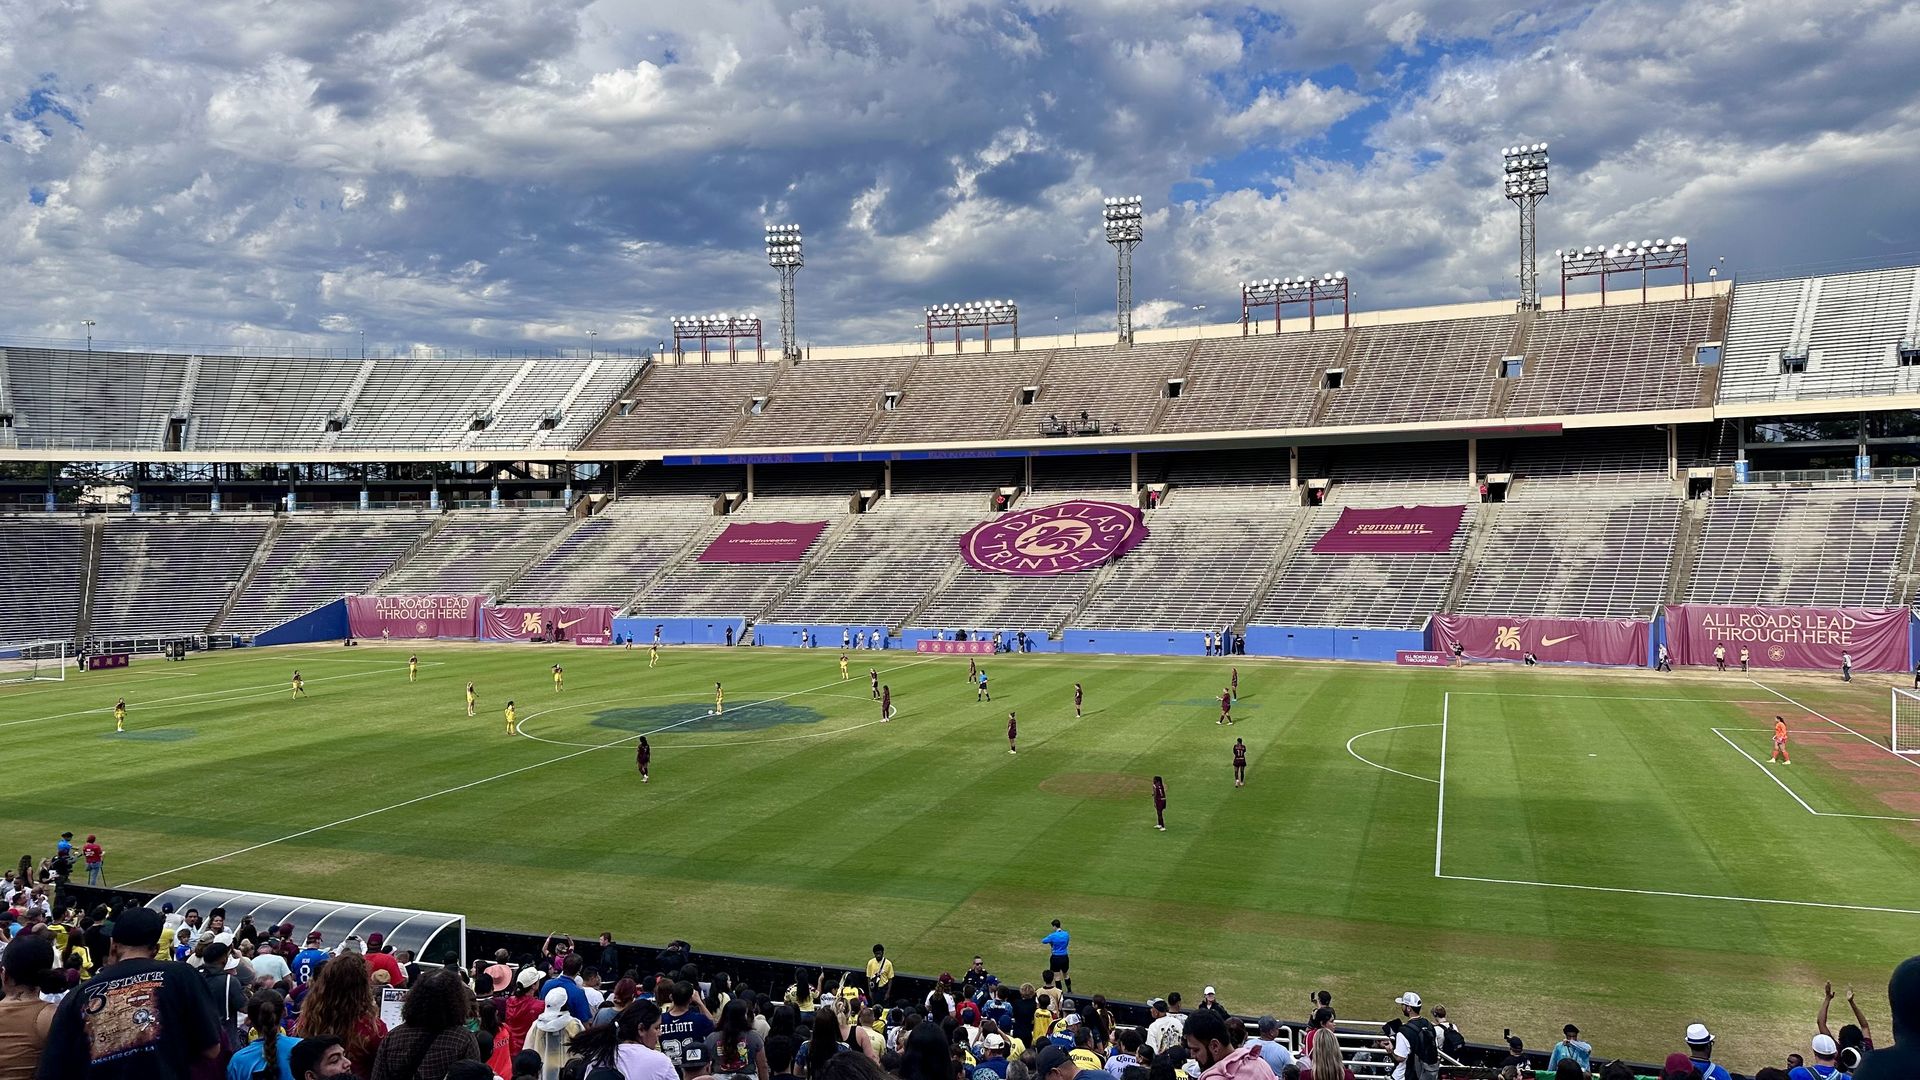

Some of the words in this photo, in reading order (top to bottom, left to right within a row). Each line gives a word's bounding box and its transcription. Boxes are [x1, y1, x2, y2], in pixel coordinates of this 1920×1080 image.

[1002, 507, 1125, 533] DALLAS
[981, 541, 1109, 569] TRINITY
[375, 598, 397, 609] ALL
[399, 598, 437, 609] ROADS
[440, 598, 470, 608] LEAD
[376, 609, 435, 620] THROUGH
[437, 609, 467, 619] HERE
[1702, 613, 1735, 627] ALL
[1739, 614, 1802, 629] ROADS
[1806, 616, 1856, 630] LEAD
[1705, 627, 1798, 643] THROUGH
[1802, 630, 1853, 645] HERE
[300, 964, 311, 984] 8
[84, 981, 108, 1015] 3
[107, 971, 165, 990] STATE
[659, 1021, 694, 1035] ELLIOTT
